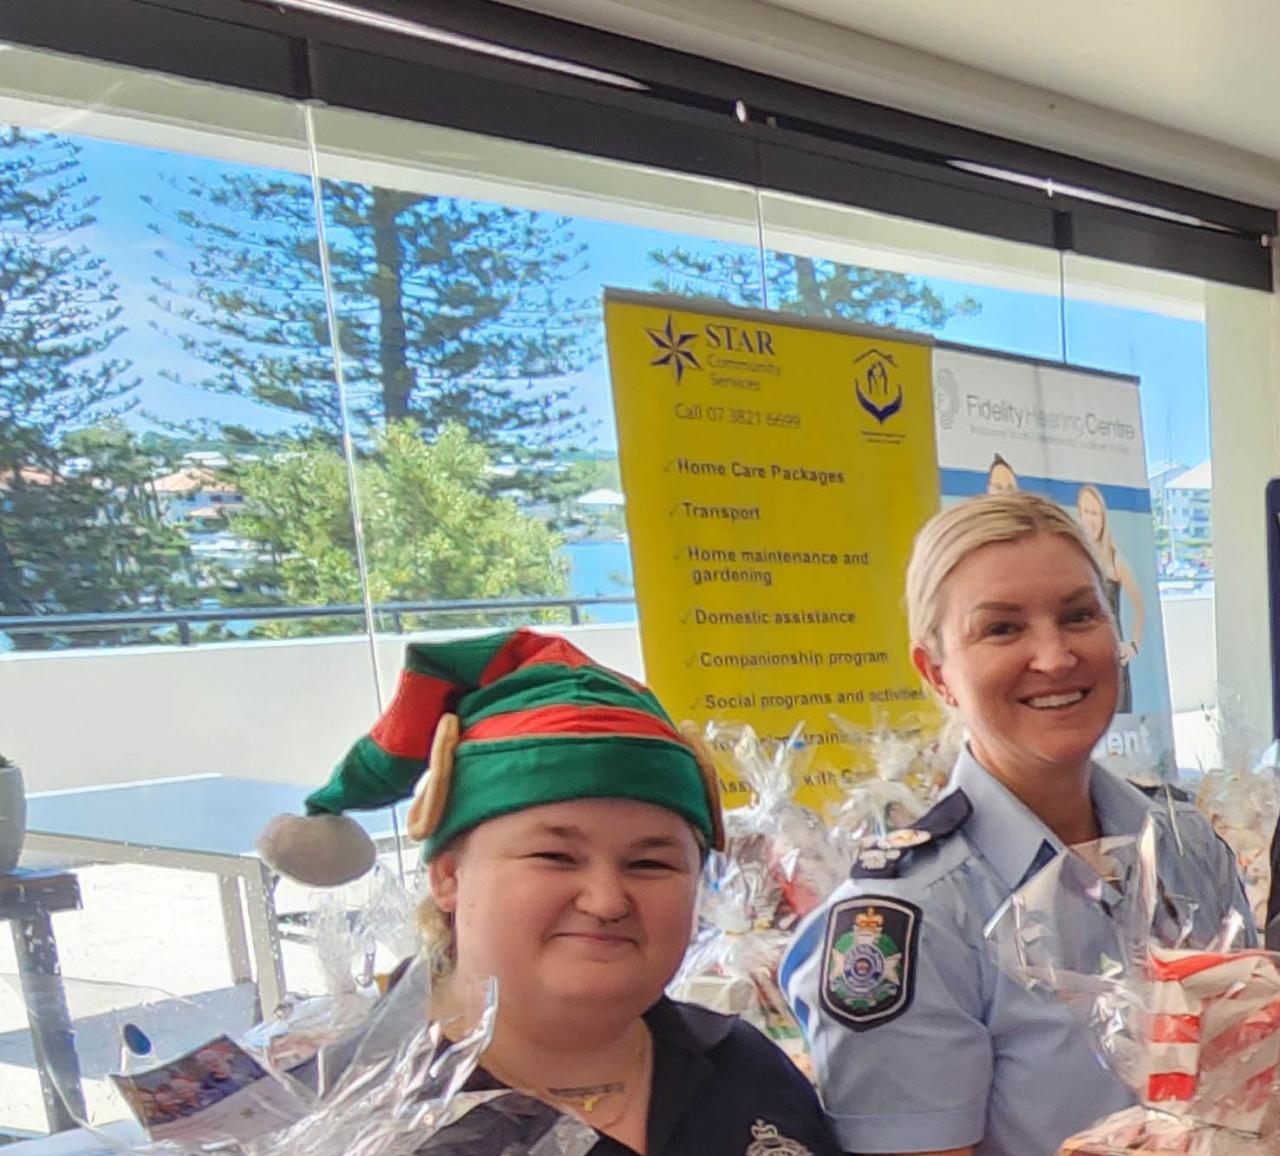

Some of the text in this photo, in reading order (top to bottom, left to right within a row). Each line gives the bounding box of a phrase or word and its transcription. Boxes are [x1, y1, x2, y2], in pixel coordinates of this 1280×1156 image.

[705, 323, 777, 356] STAR
[674, 402, 703, 420] Call
[966, 394, 1024, 428] Fidelity
[1085, 413, 1135, 440] Centre
[677, 458, 845, 487] Home Care Packages
[683, 502, 761, 522] Transport
[687, 545, 870, 566] Home maintenance and
[692, 567, 773, 587] gardening
[695, 608, 857, 625] Domestic assistance
[700, 648, 889, 669] Companionship program
[705, 692, 757, 711] Social
[760, 692, 833, 714] programs
[837, 688, 865, 705] and
